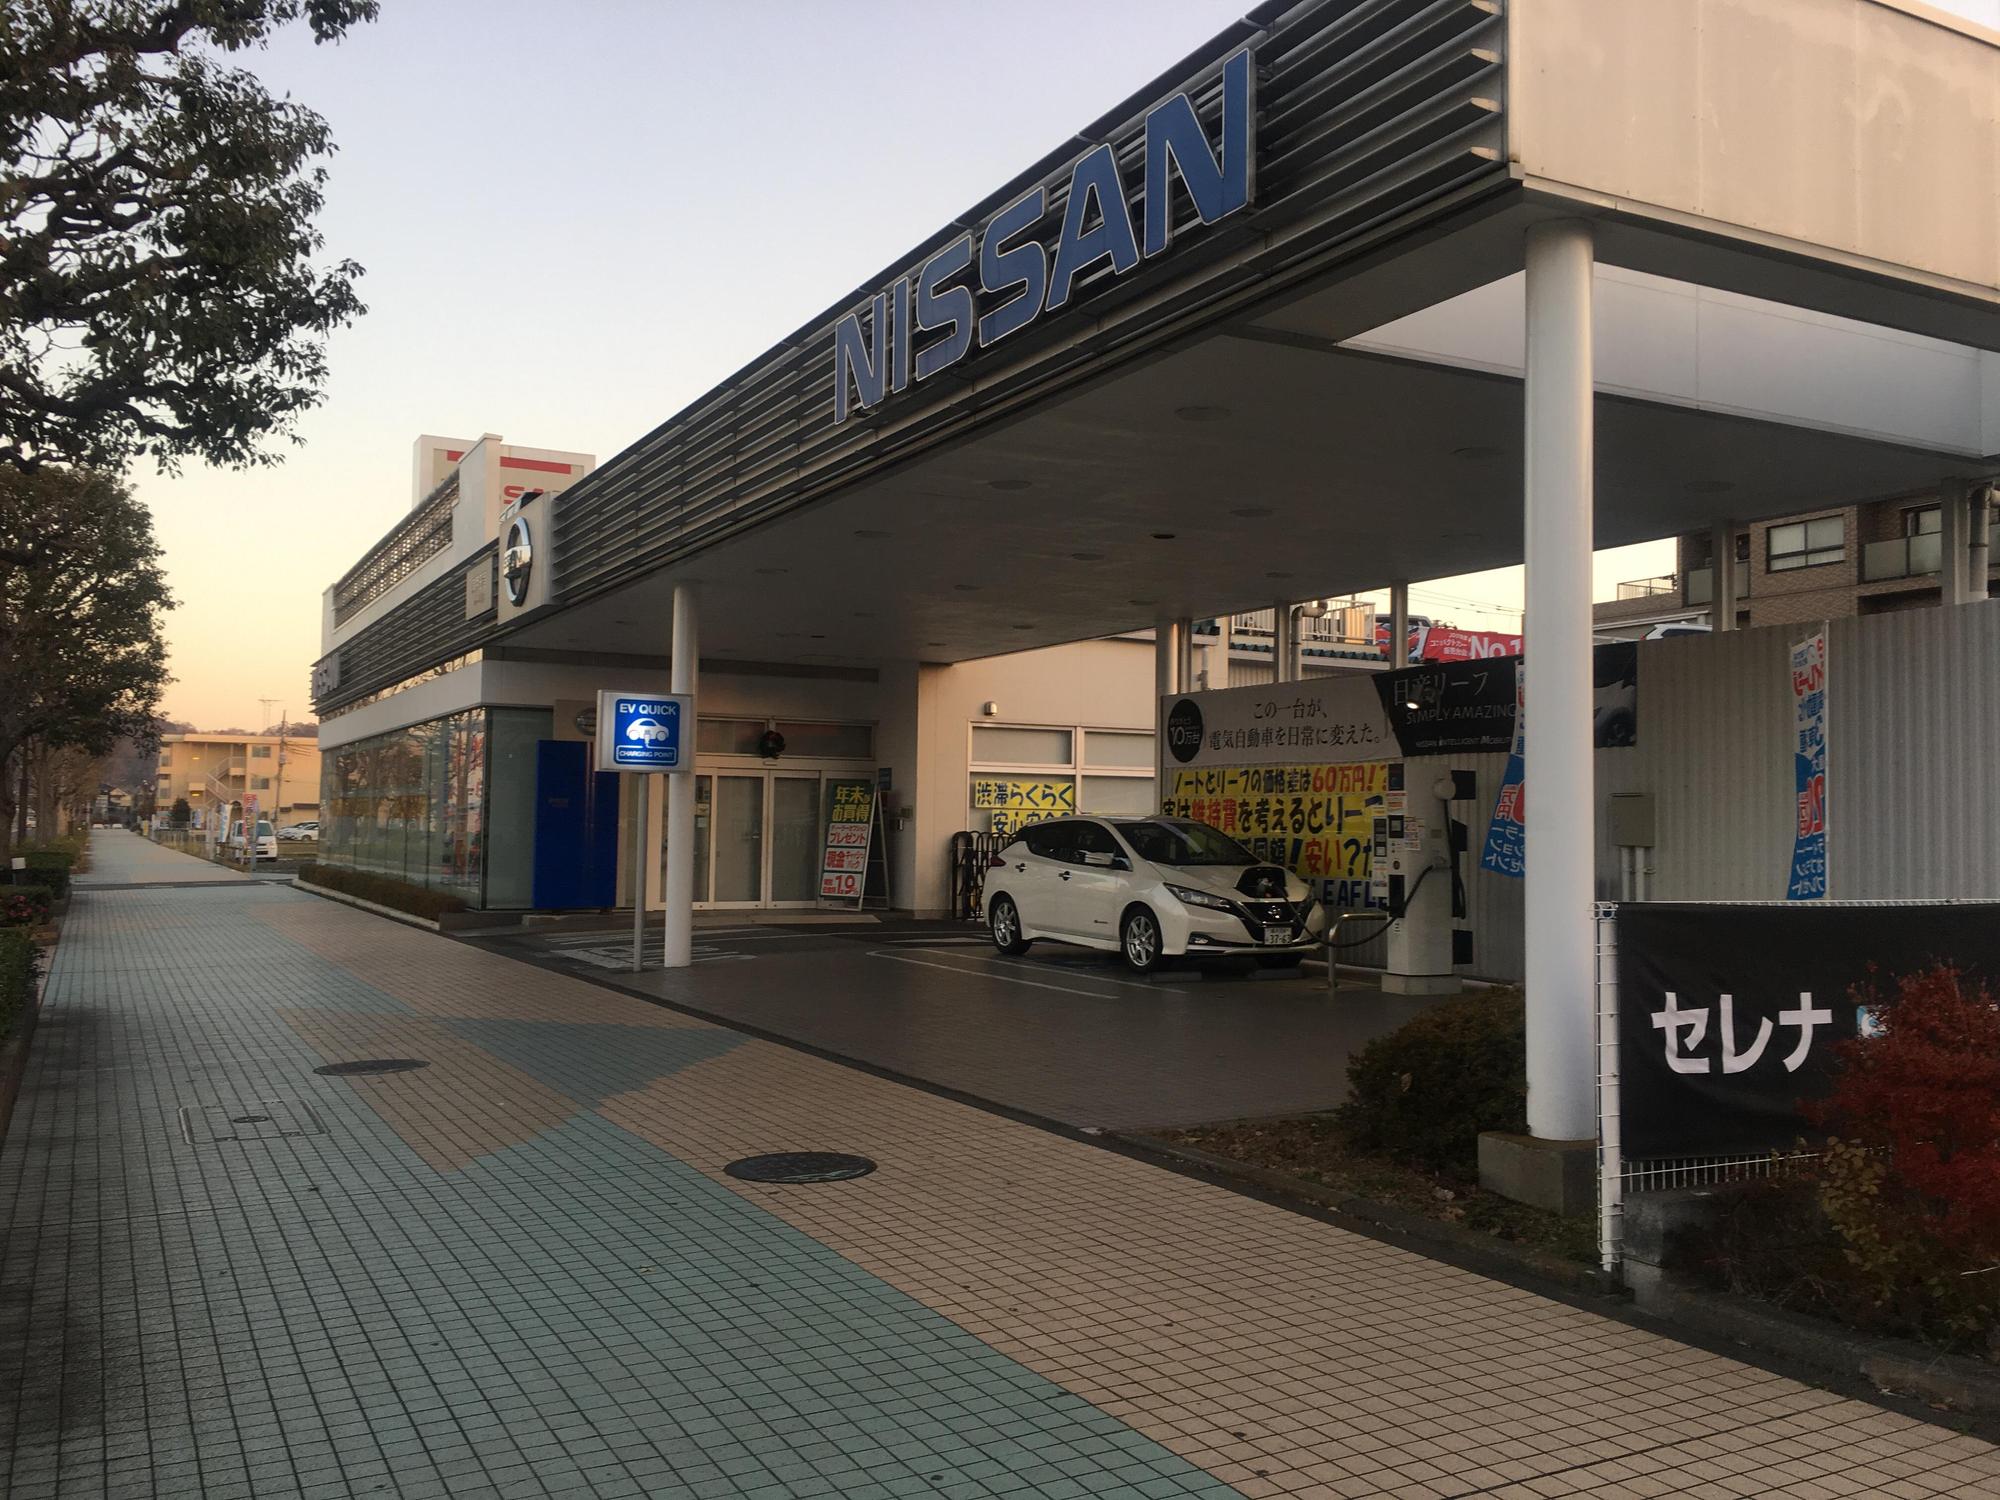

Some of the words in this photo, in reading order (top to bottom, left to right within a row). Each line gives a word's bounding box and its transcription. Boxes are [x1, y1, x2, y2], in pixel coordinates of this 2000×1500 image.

[834, 48, 1255, 425] NISSAN
[619, 703, 636, 714] EV
[638, 704, 676, 716] QUICK
[1253, 698, 1328, 719] この一台が、
[1406, 709, 1450, 725] SIMPLY
[1453, 704, 1516, 720] AMAZING
[1209, 723, 1380, 750] 電気自動車を日常に変えた。
[619, 750, 653, 758] CHARGING
[653, 751, 674, 759] POINT
[977, 782, 1073, 808] 渋滞らくらく
[830, 832, 866, 844] プレゼント
[1651, 991, 1833, 1074] セレナ
